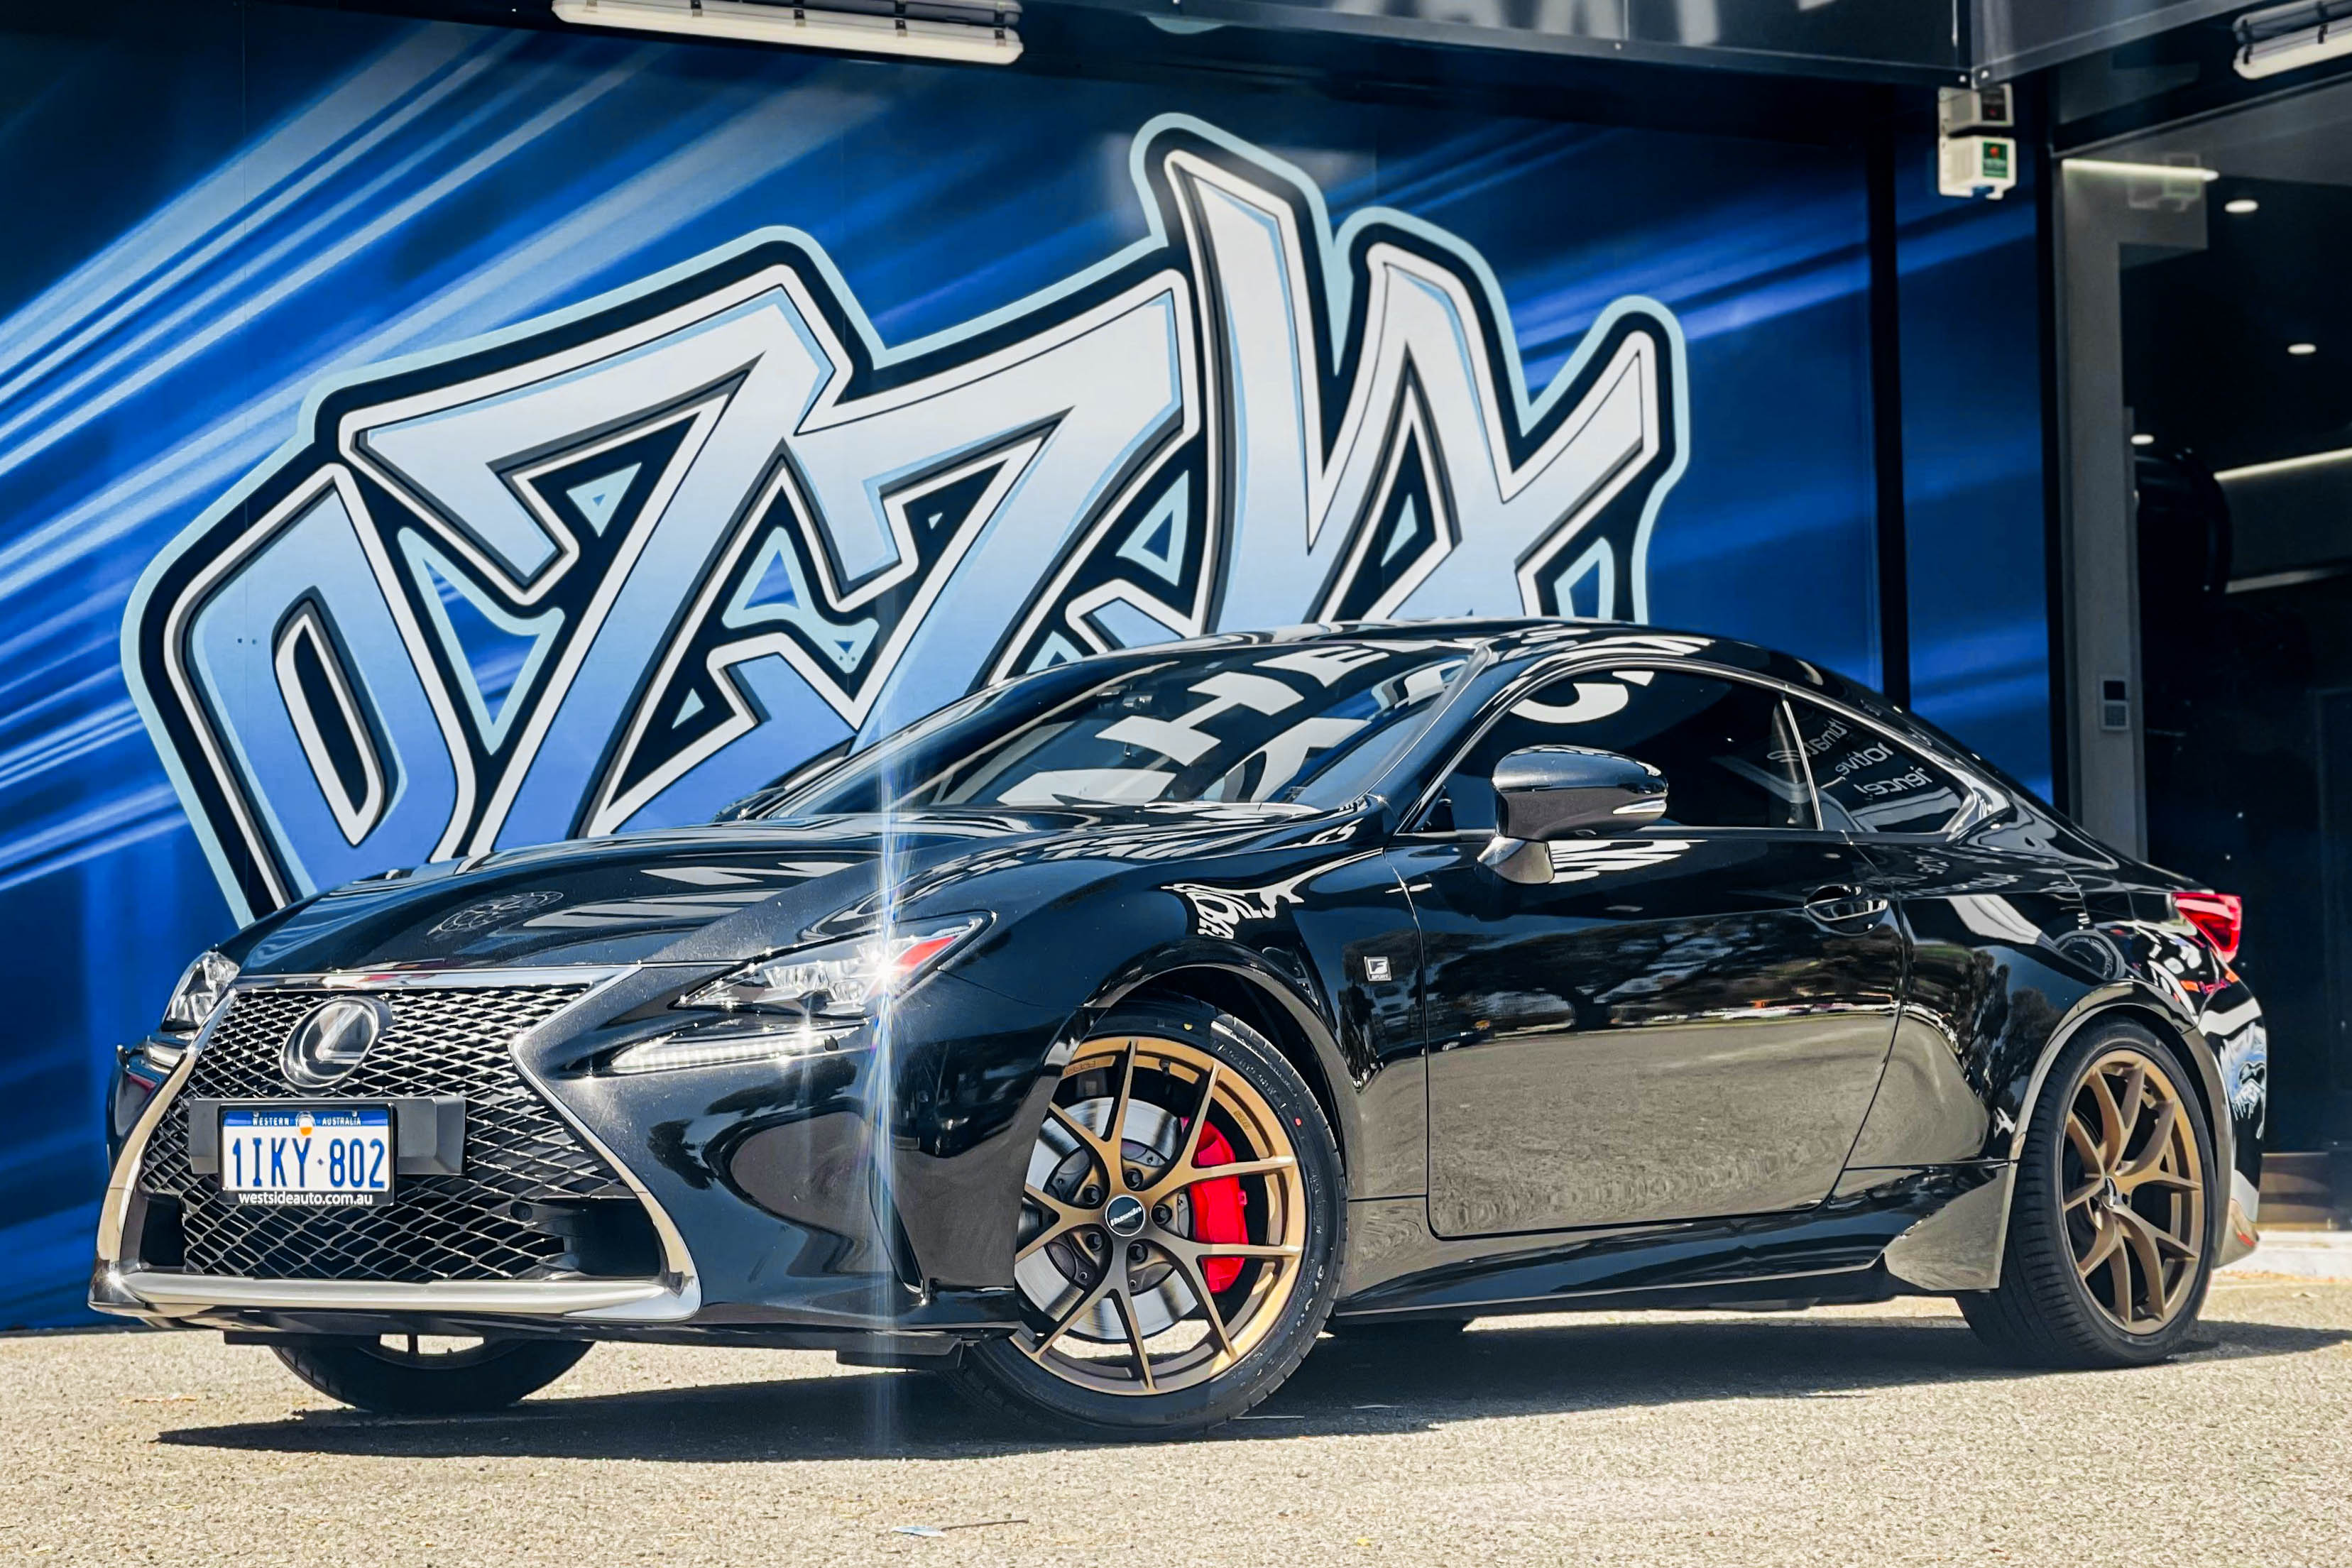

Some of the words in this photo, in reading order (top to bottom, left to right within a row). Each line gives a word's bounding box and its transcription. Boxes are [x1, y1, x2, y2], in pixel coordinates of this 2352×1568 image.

[252, 1117, 290, 1126] WESTERN
[322, 1117, 361, 1126] AUSTRALIA
[238, 1191, 373, 1205] westsideauto.com.au
